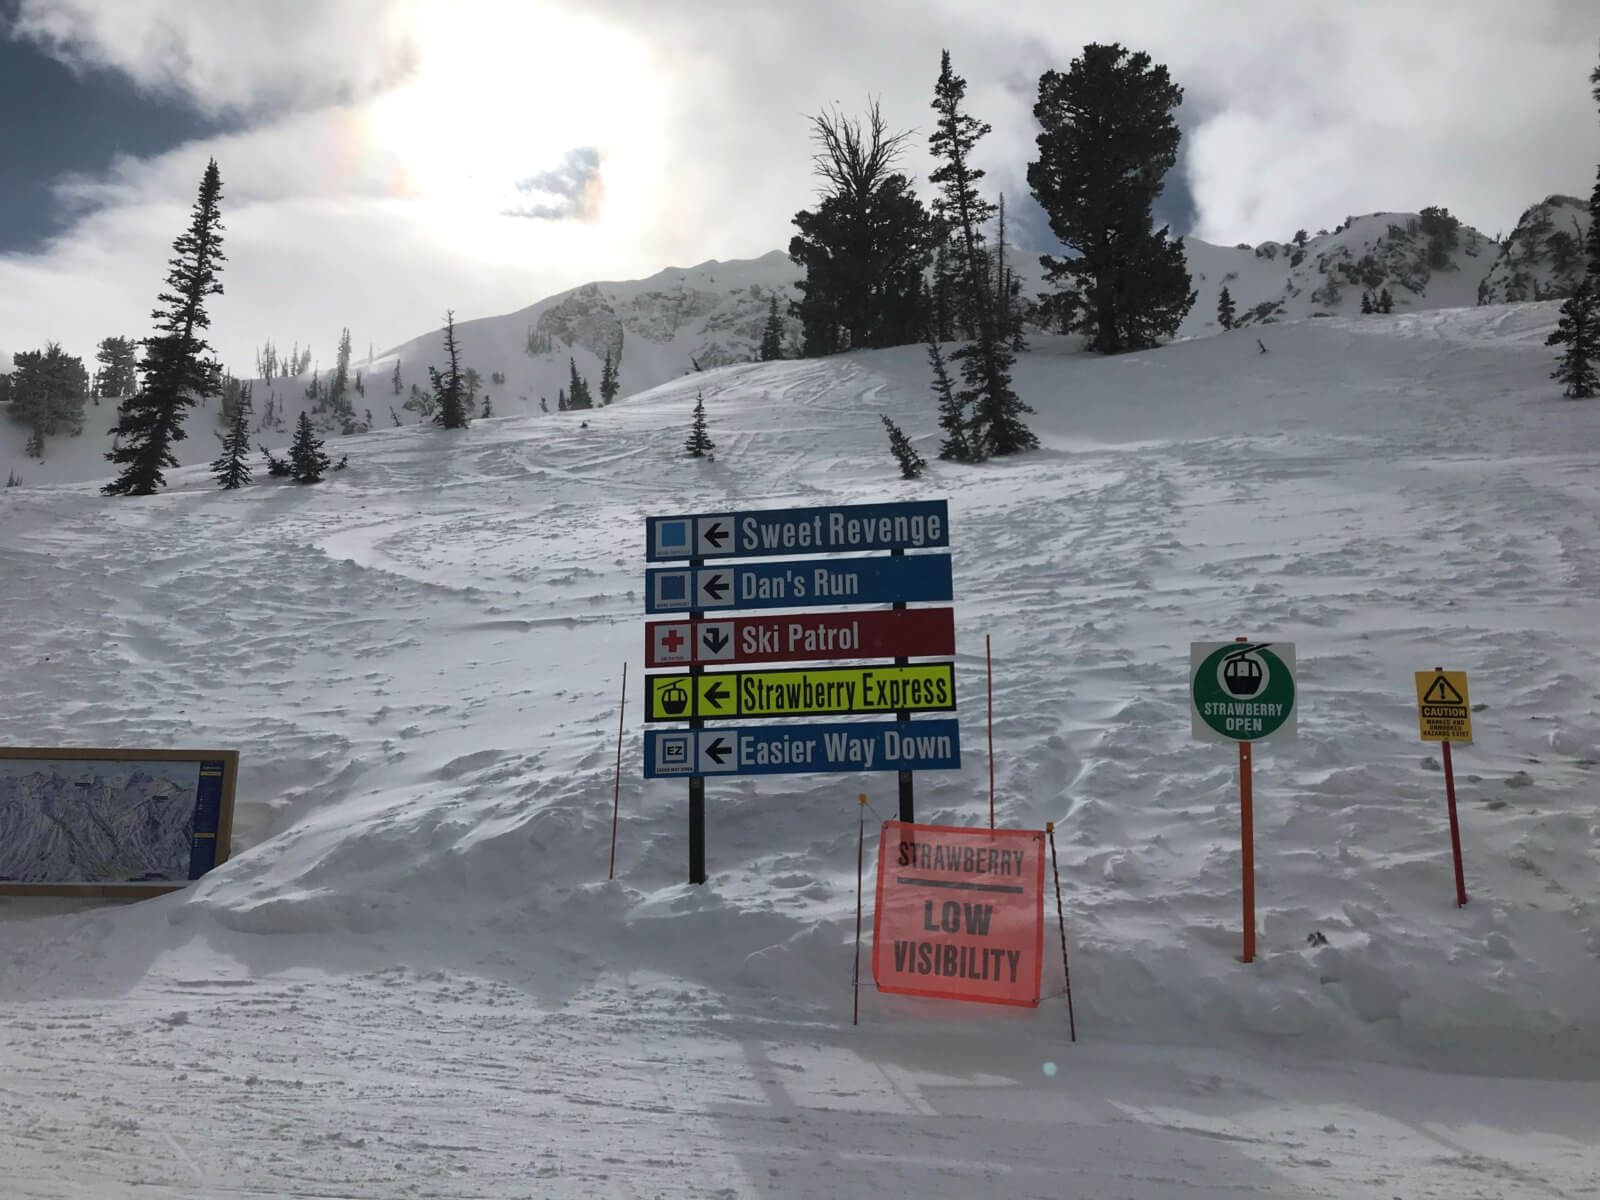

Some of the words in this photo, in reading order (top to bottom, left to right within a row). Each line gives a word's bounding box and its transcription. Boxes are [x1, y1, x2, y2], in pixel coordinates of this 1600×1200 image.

[742, 515, 822, 550] Sweet
[829, 512, 941, 546] Revenge
[742, 570, 805, 600] Dan's
[814, 568, 859, 597] Run
[742, 624, 779, 654] Ski
[788, 621, 859, 652] Patrol
[743, 675, 856, 711] Strawberry
[862, 672, 947, 709] Express
[1204, 702, 1283, 717] STRAWBERRY
[1226, 717, 1263, 732] OPEN
[1424, 707, 1466, 717] CAUTION
[667, 746, 683, 756] EZ
[740, 734, 816, 766] Easier
[824, 732, 876, 768] Way
[884, 730, 951, 761] Down
[898, 841, 1025, 877] STRAWBERRY
[923, 899, 993, 937] LOW
[893, 939, 1021, 983] VISIBILITY
